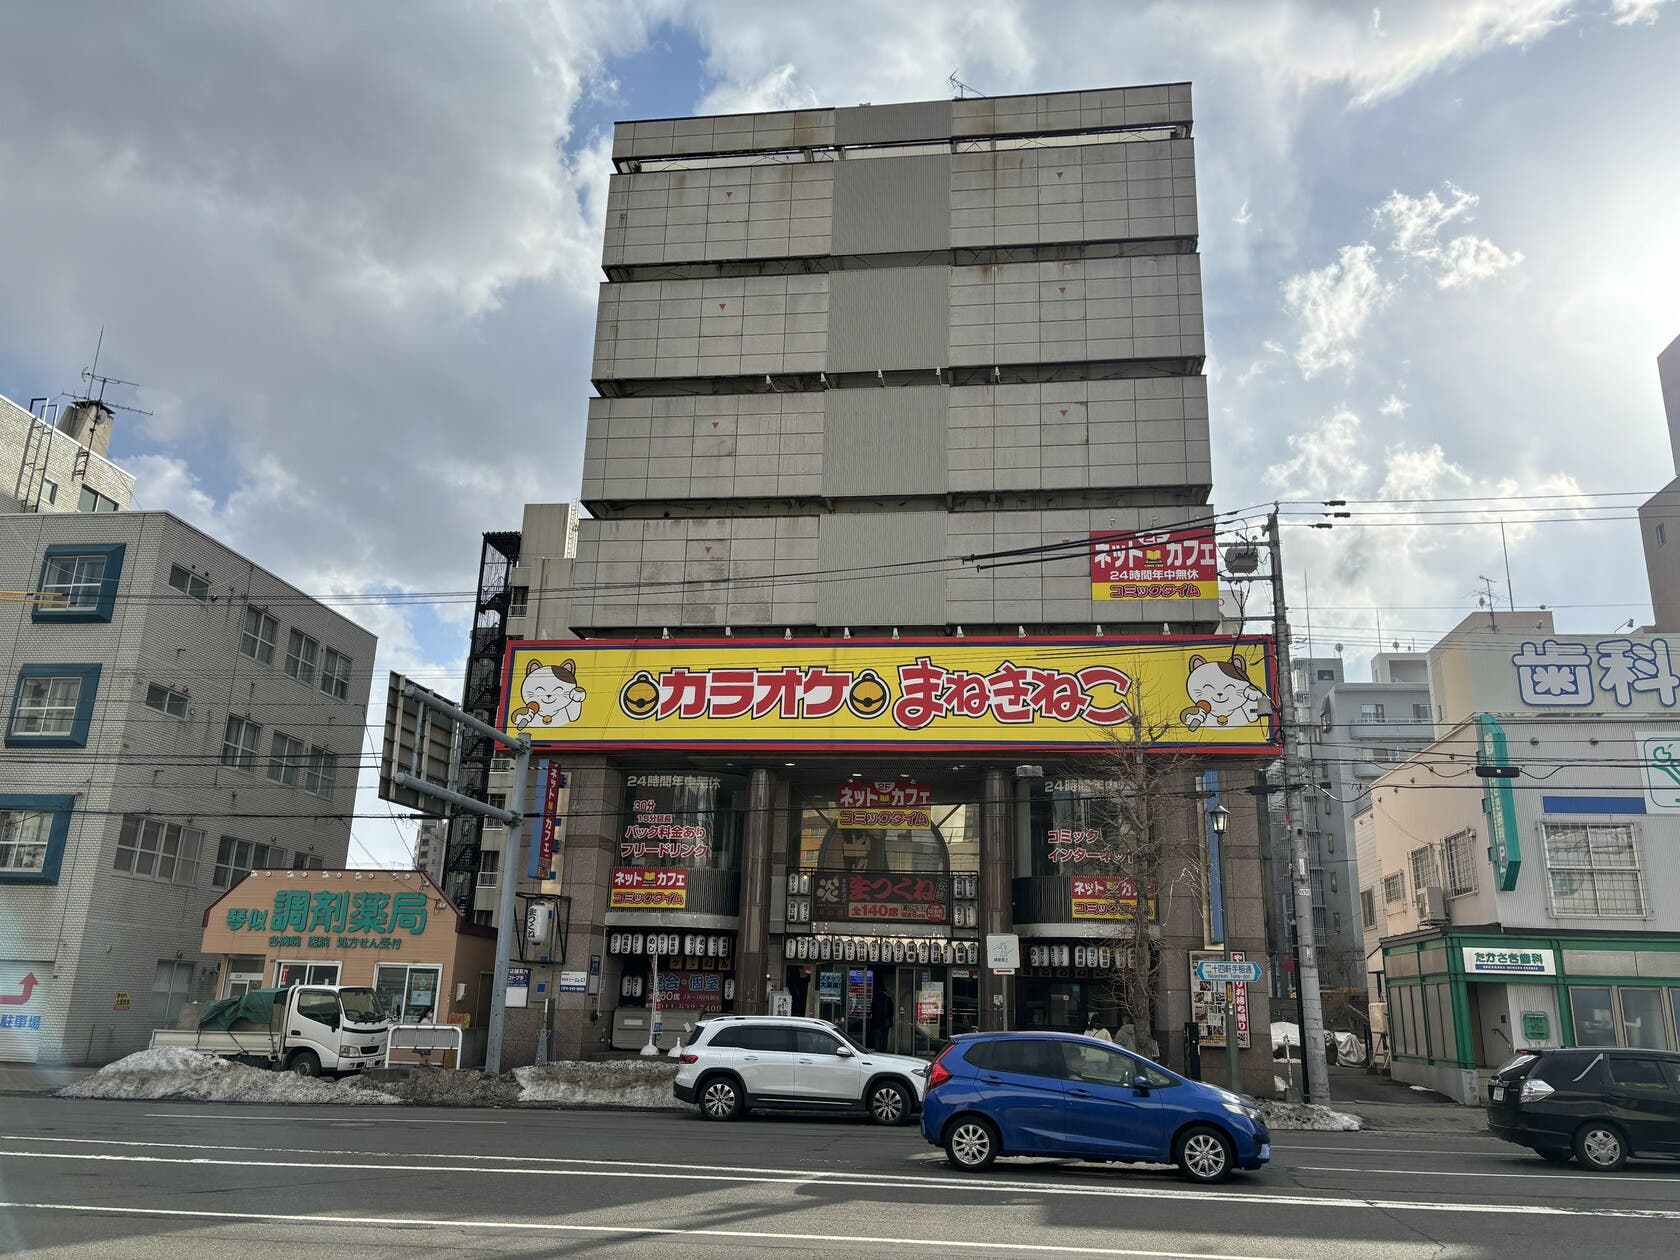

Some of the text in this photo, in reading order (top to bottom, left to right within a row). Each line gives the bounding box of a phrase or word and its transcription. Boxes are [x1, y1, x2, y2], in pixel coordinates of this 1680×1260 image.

[1094, 541, 1215, 568] ネット カフェ
[1110, 569, 1199, 581] 24時間年中無休
[1110, 584, 1201, 599] コミックタイム
[1512, 638, 1680, 708] 歯科
[656, 655, 1133, 729] カラオケ まねきねこ
[549, 768, 558, 800] ネット
[840, 787, 930, 807] ネット カフェ
[840, 811, 928, 826] コミックタイム
[1047, 829, 1099, 843] コミック
[621, 843, 708, 858] フリードリンク
[614, 872, 686, 886] ネット カフェ
[1074, 881, 1104, 895] ネット
[612, 892, 684, 905] コミックタイム
[226, 890, 428, 935] 琴似 調剤薬局
[1474, 952, 1543, 964] たかさき歯科
[0, 1014, 41, 1031] 駐車場
